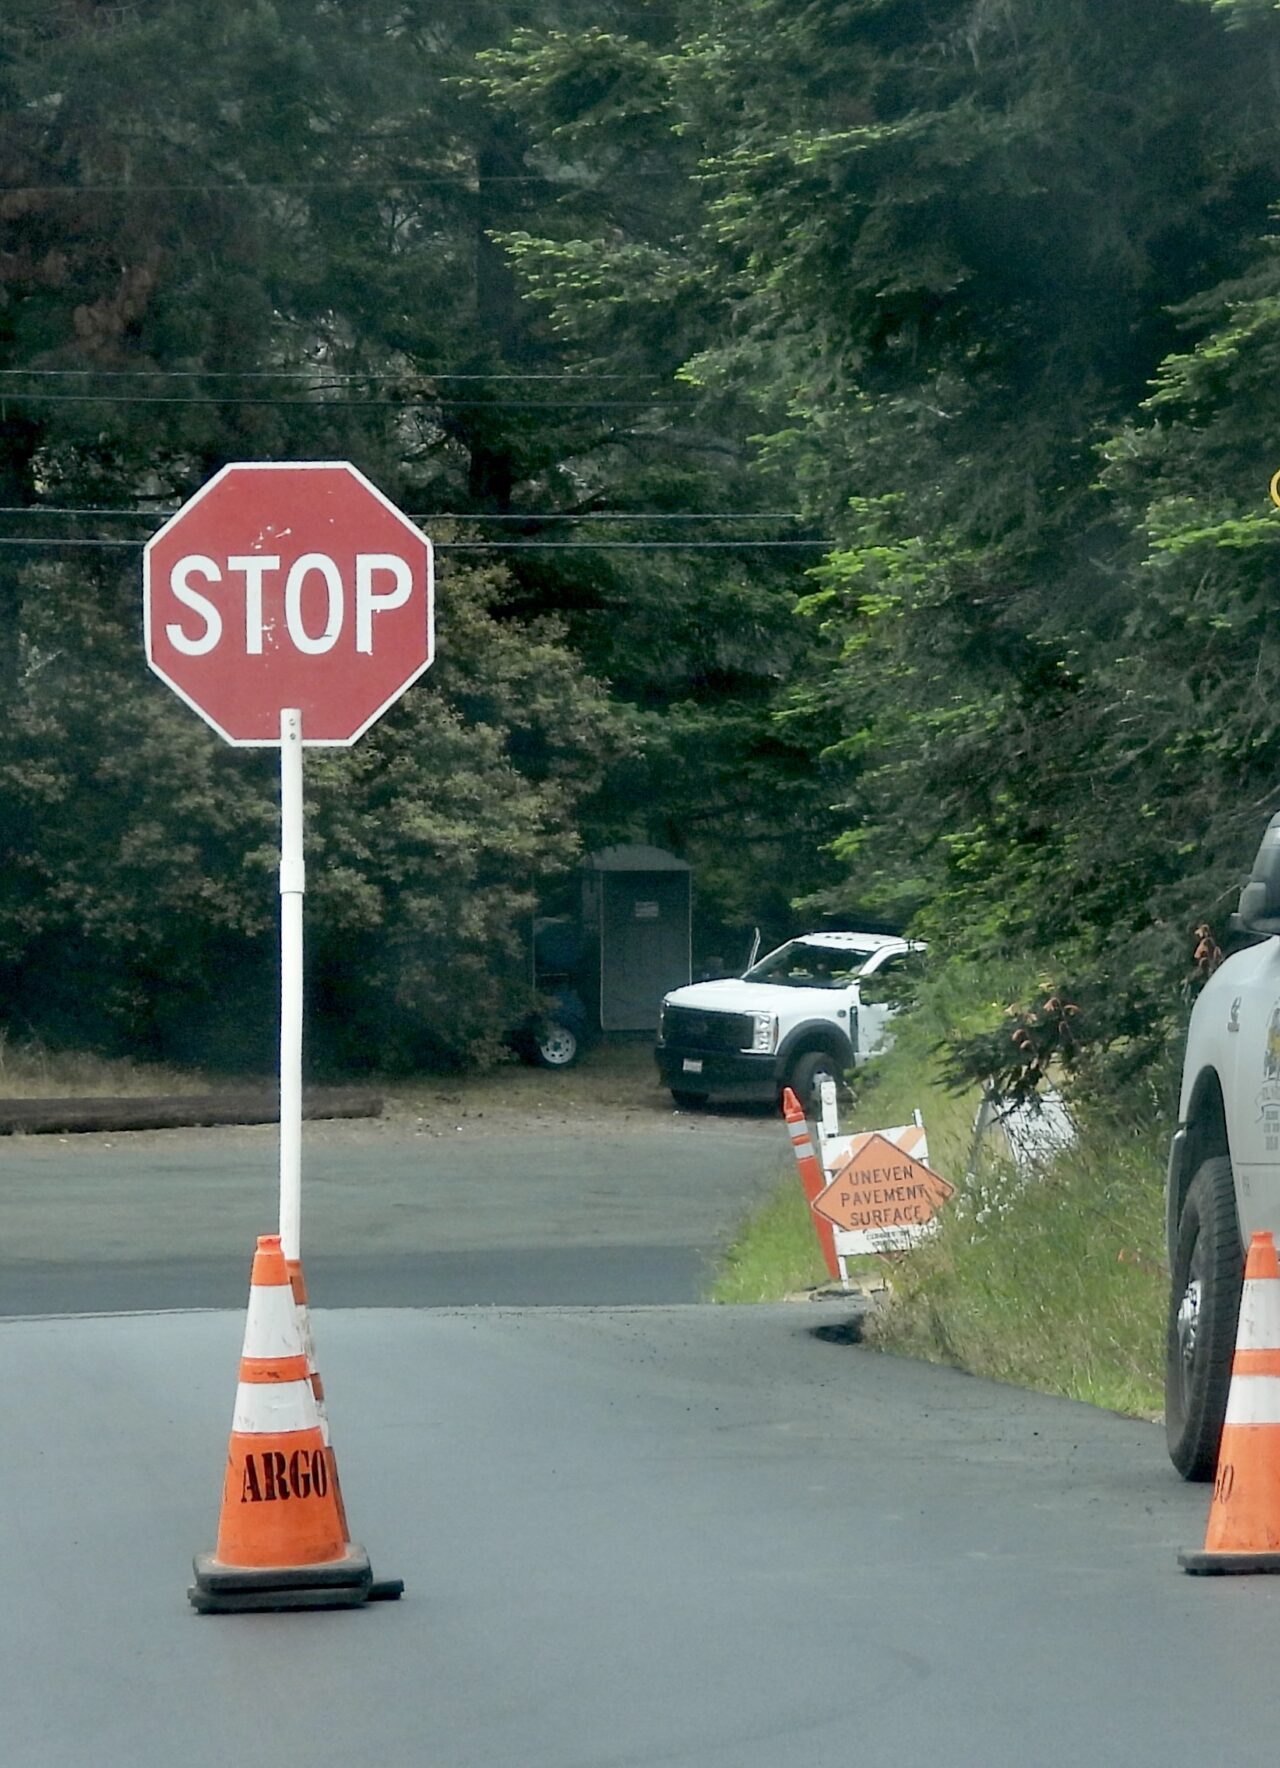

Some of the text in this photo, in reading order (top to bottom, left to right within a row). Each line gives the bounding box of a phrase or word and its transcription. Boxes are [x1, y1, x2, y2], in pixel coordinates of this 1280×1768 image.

[165, 552, 413, 656] STOP
[848, 1164, 914, 1186] UNEVEN
[840, 1183, 926, 1208] PAVEMENT
[850, 1205, 923, 1227] SURFACE
[241, 1449, 328, 1503] ARGO
